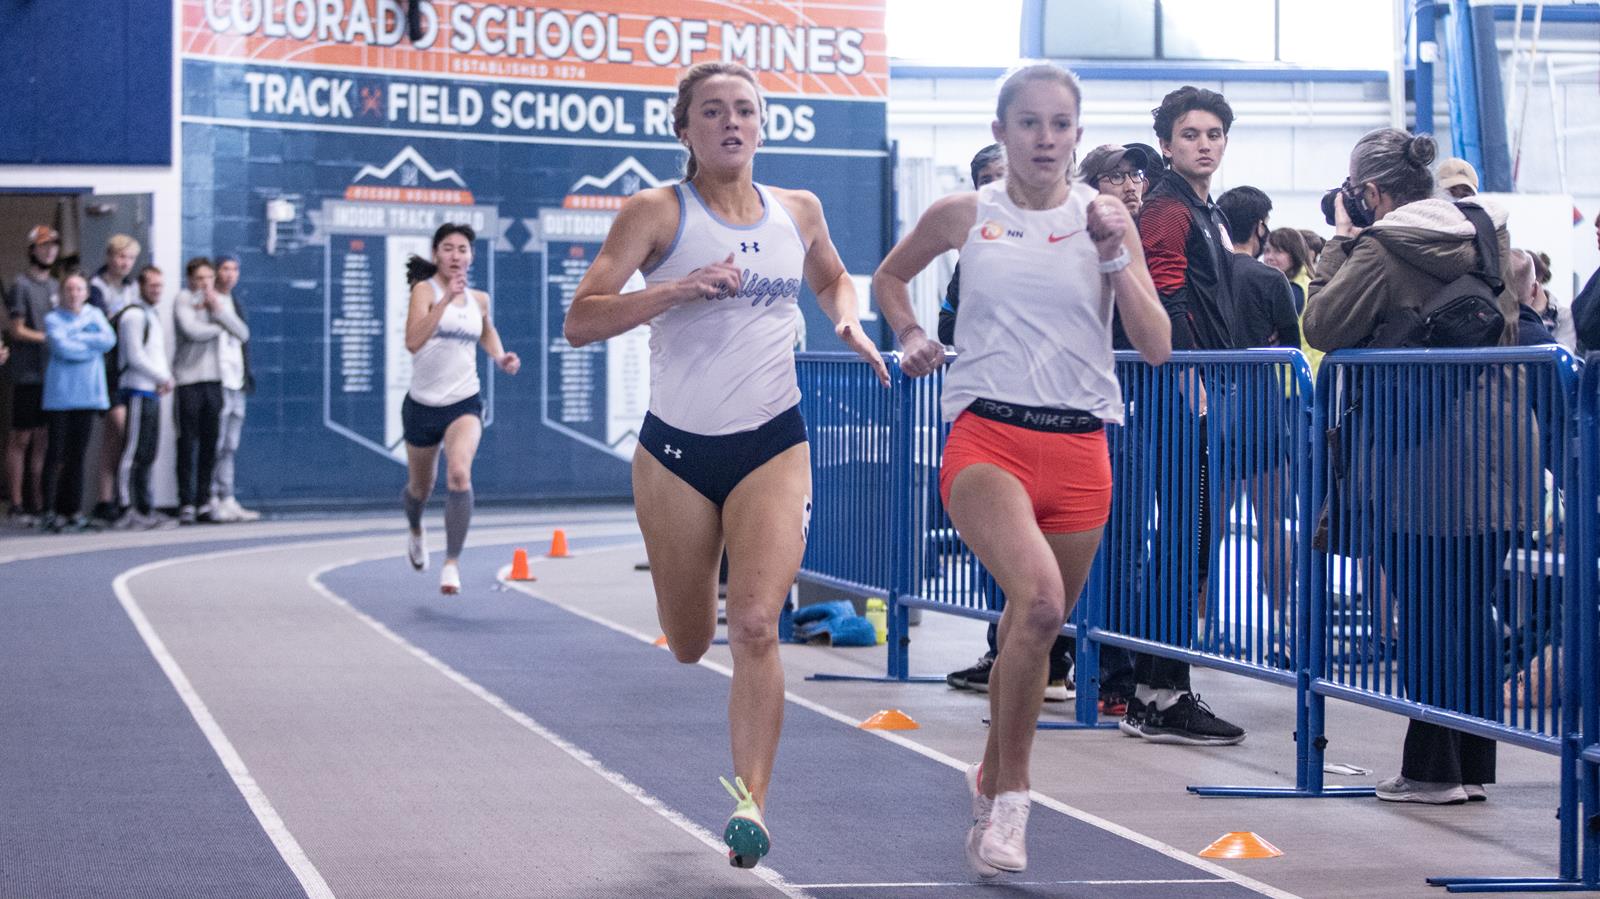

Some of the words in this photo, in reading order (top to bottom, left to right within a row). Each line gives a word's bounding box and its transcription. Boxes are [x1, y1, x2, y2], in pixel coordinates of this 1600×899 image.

[204, 0, 438, 50] COLORADO
[451, 3, 633, 63] SCHOOL
[644, 16, 709, 67] OF
[720, 20, 866, 75] MINES
[244, 72, 353, 118] TRACK
[388, 83, 484, 126] FIELD
[491, 89, 635, 135] SCHOOL
[1007, 229, 1024, 239] NN
